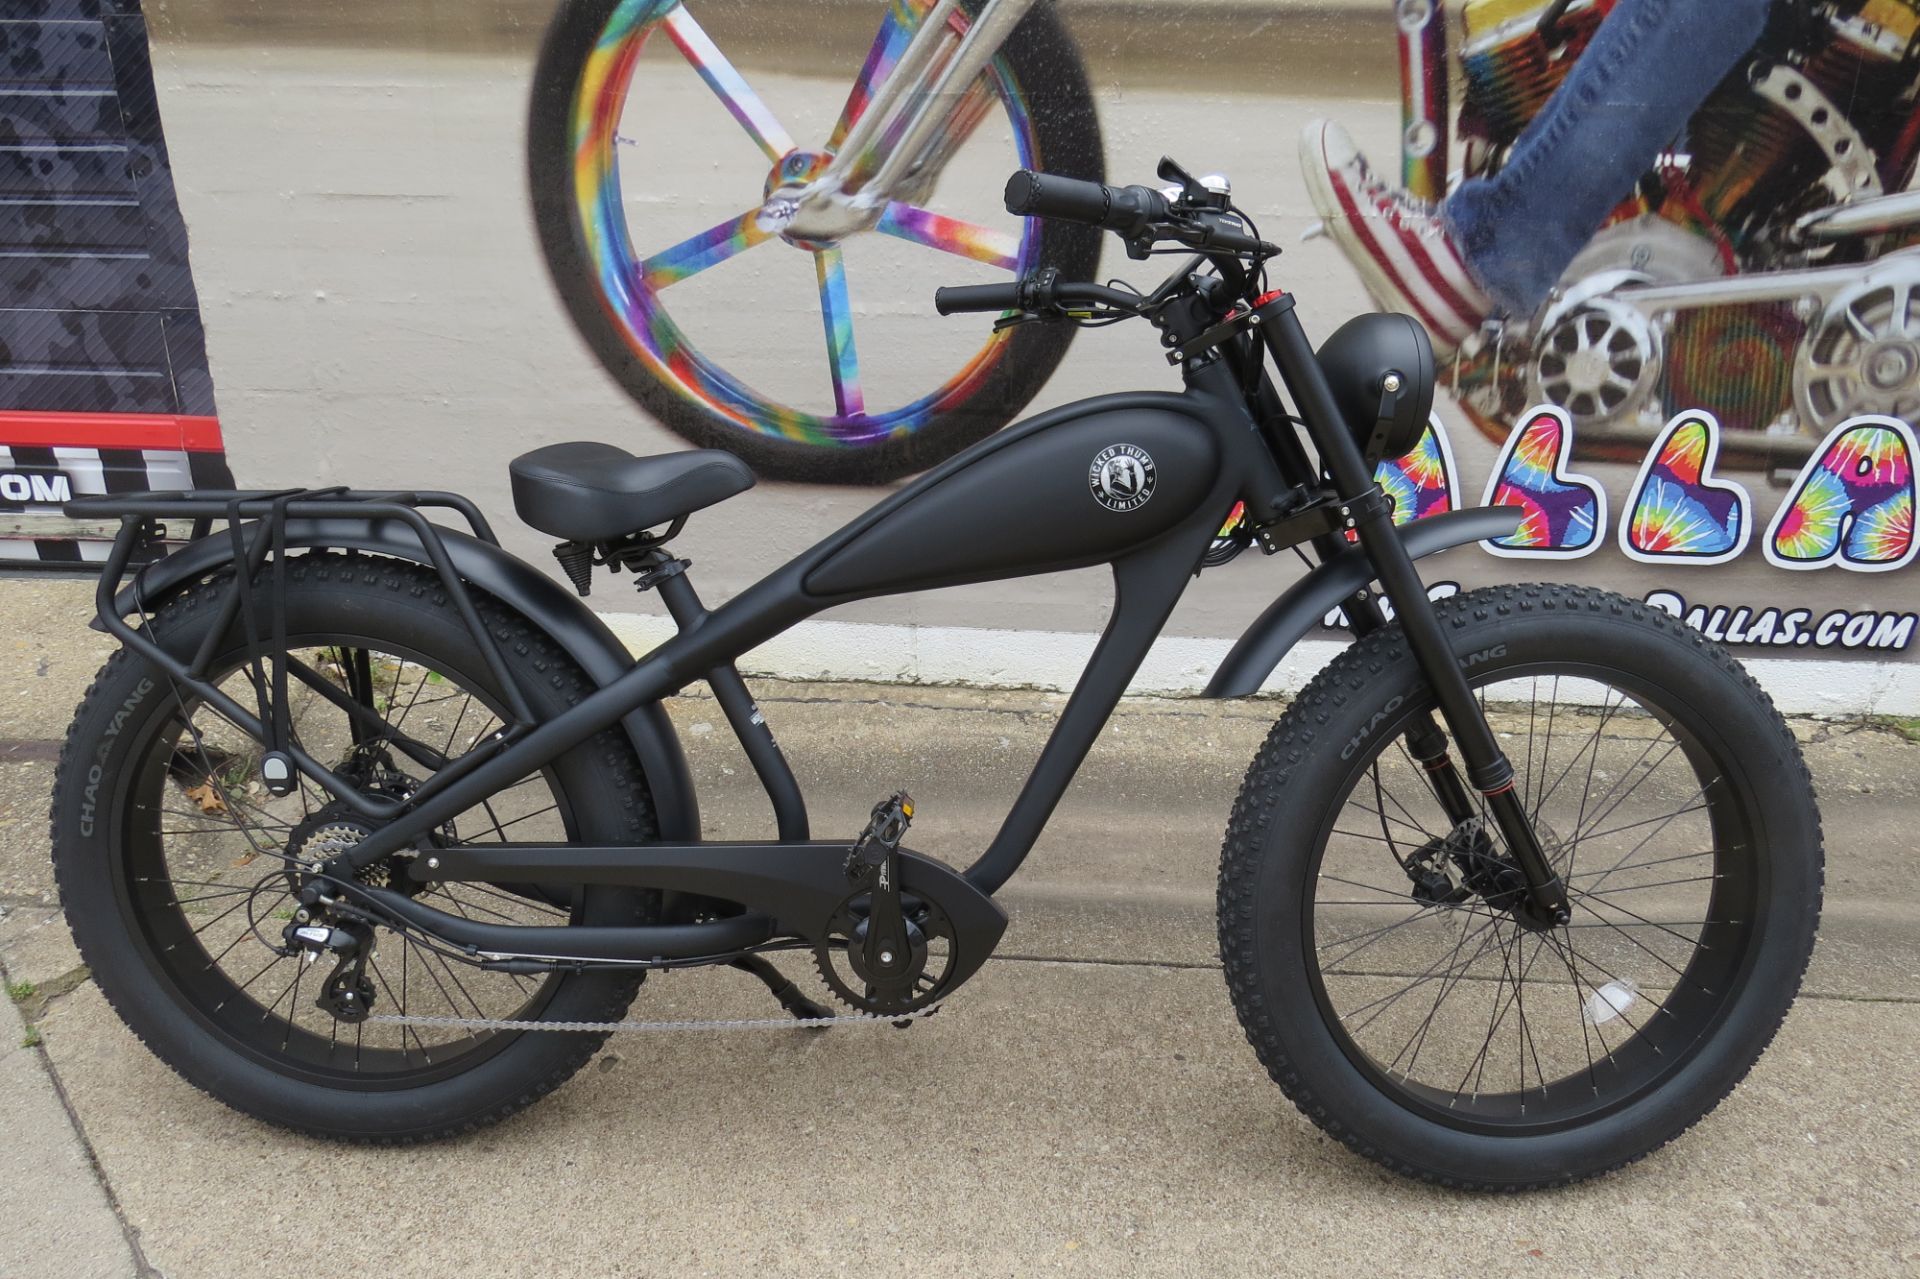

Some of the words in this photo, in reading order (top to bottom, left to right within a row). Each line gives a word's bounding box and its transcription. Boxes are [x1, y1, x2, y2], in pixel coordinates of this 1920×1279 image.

[1091, 449, 1115, 487] WICKED
[1120, 446, 1153, 471] THUMB
[1106, 489, 1150, 509] LIMITED
[1340, 695, 1404, 761] CHAO
[80, 764, 102, 838] CHAO
[105, 677, 154, 736] YANG
